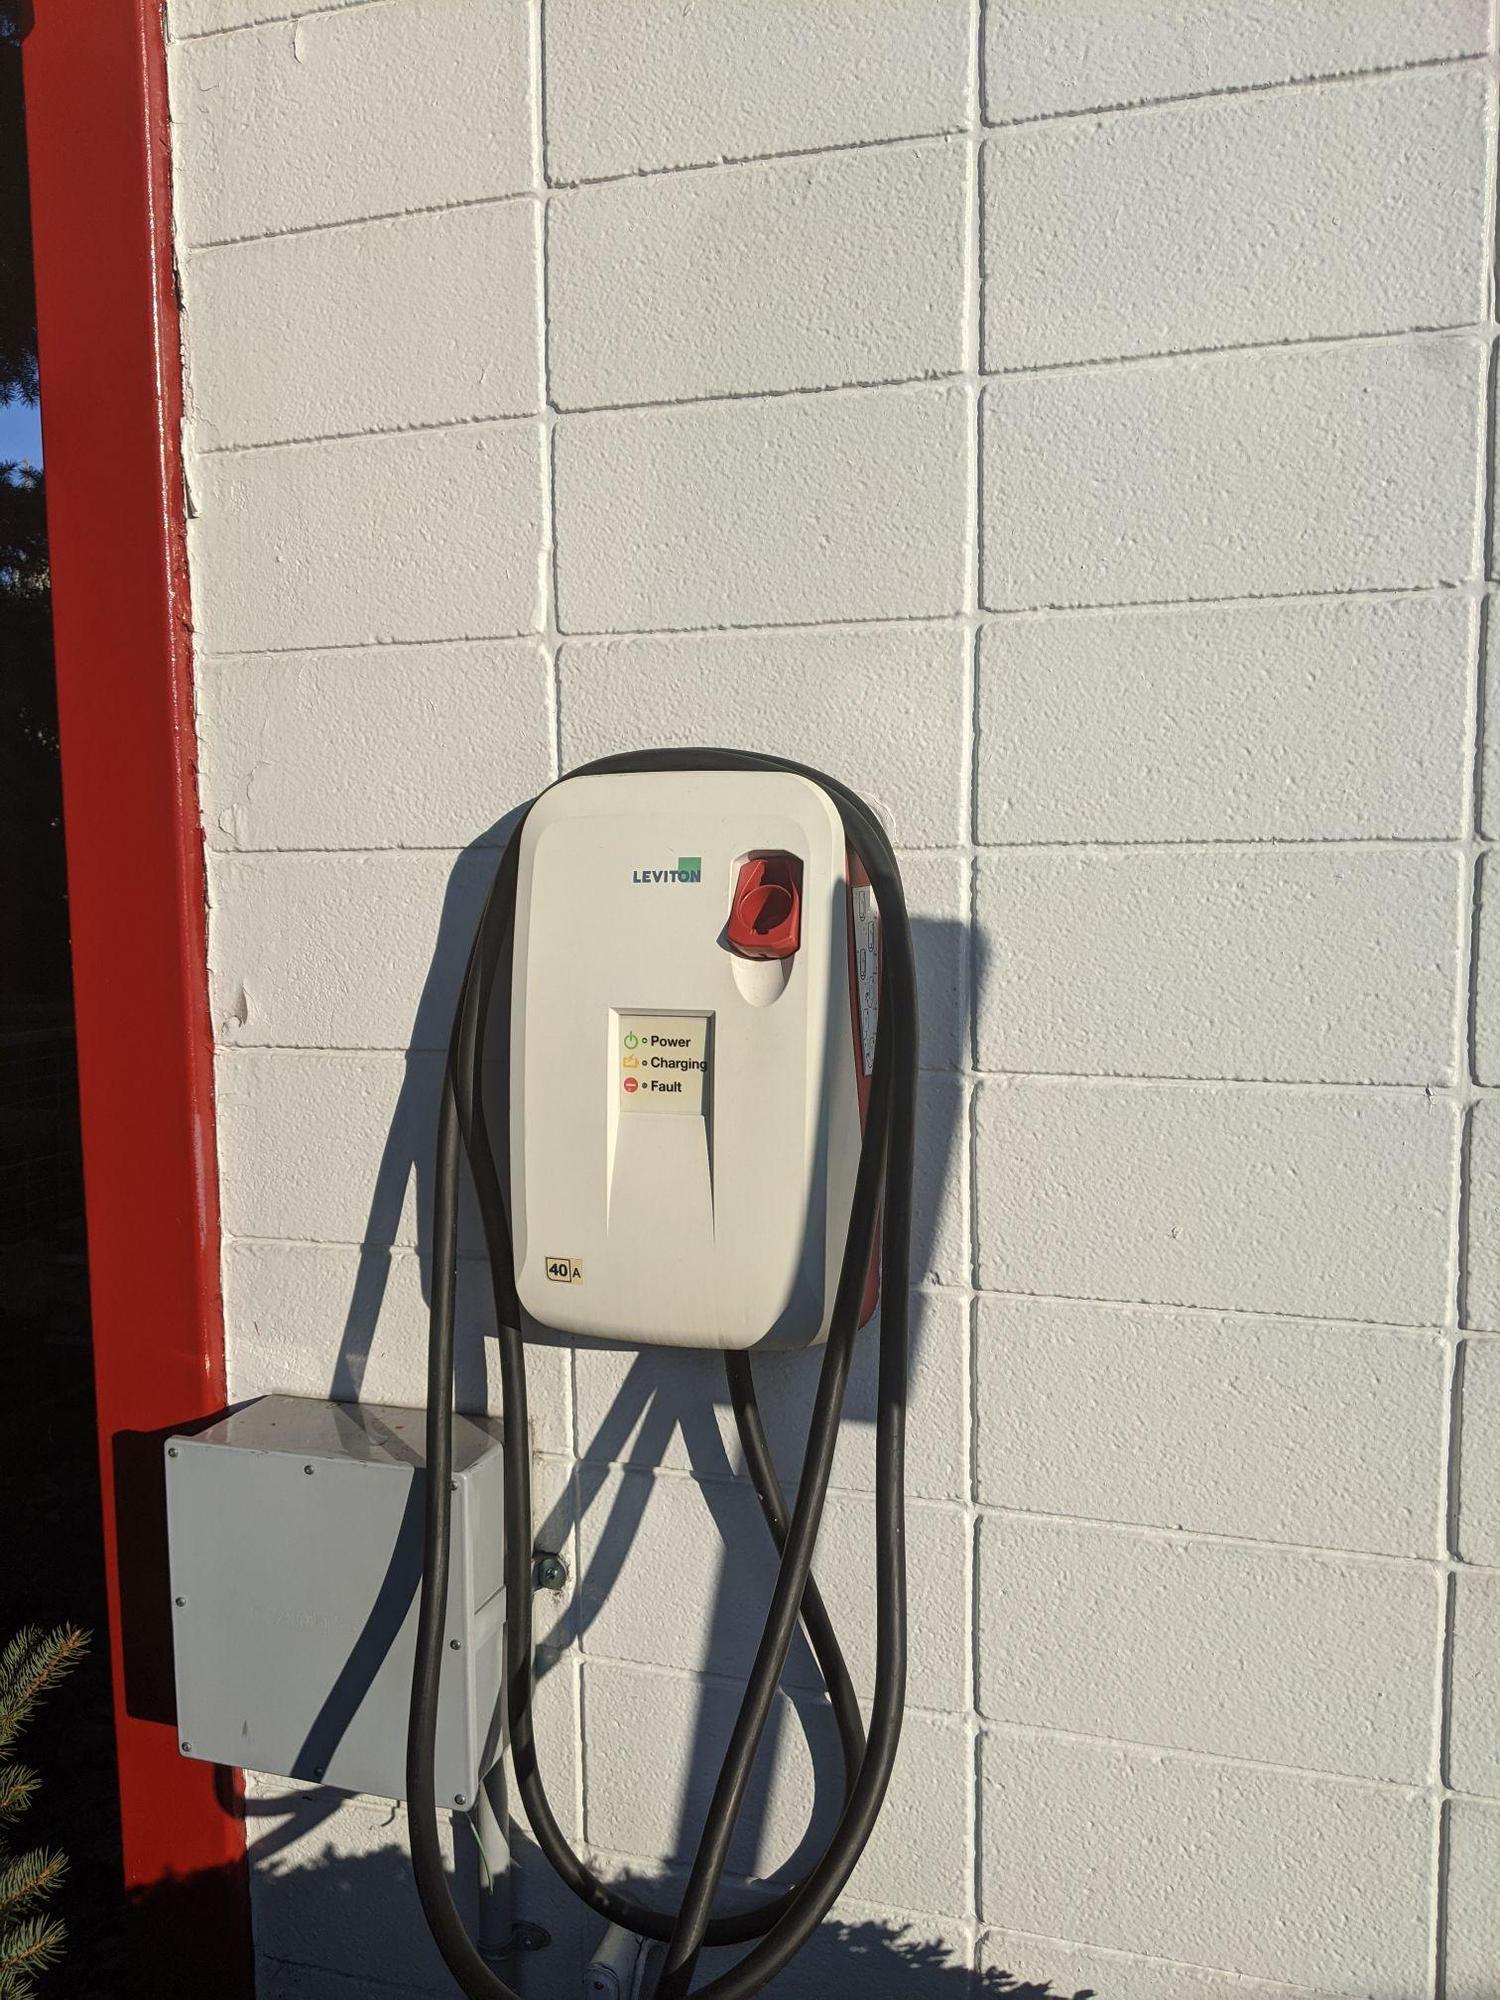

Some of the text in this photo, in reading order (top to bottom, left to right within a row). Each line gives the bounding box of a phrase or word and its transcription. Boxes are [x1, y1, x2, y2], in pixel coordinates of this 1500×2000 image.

[633, 870, 701, 883] LEVITON
[651, 1035, 691, 1048] Power
[651, 1056, 708, 1072] Charging
[651, 1080, 682, 1092] Fault
[549, 1263, 581, 1278] 40 A
